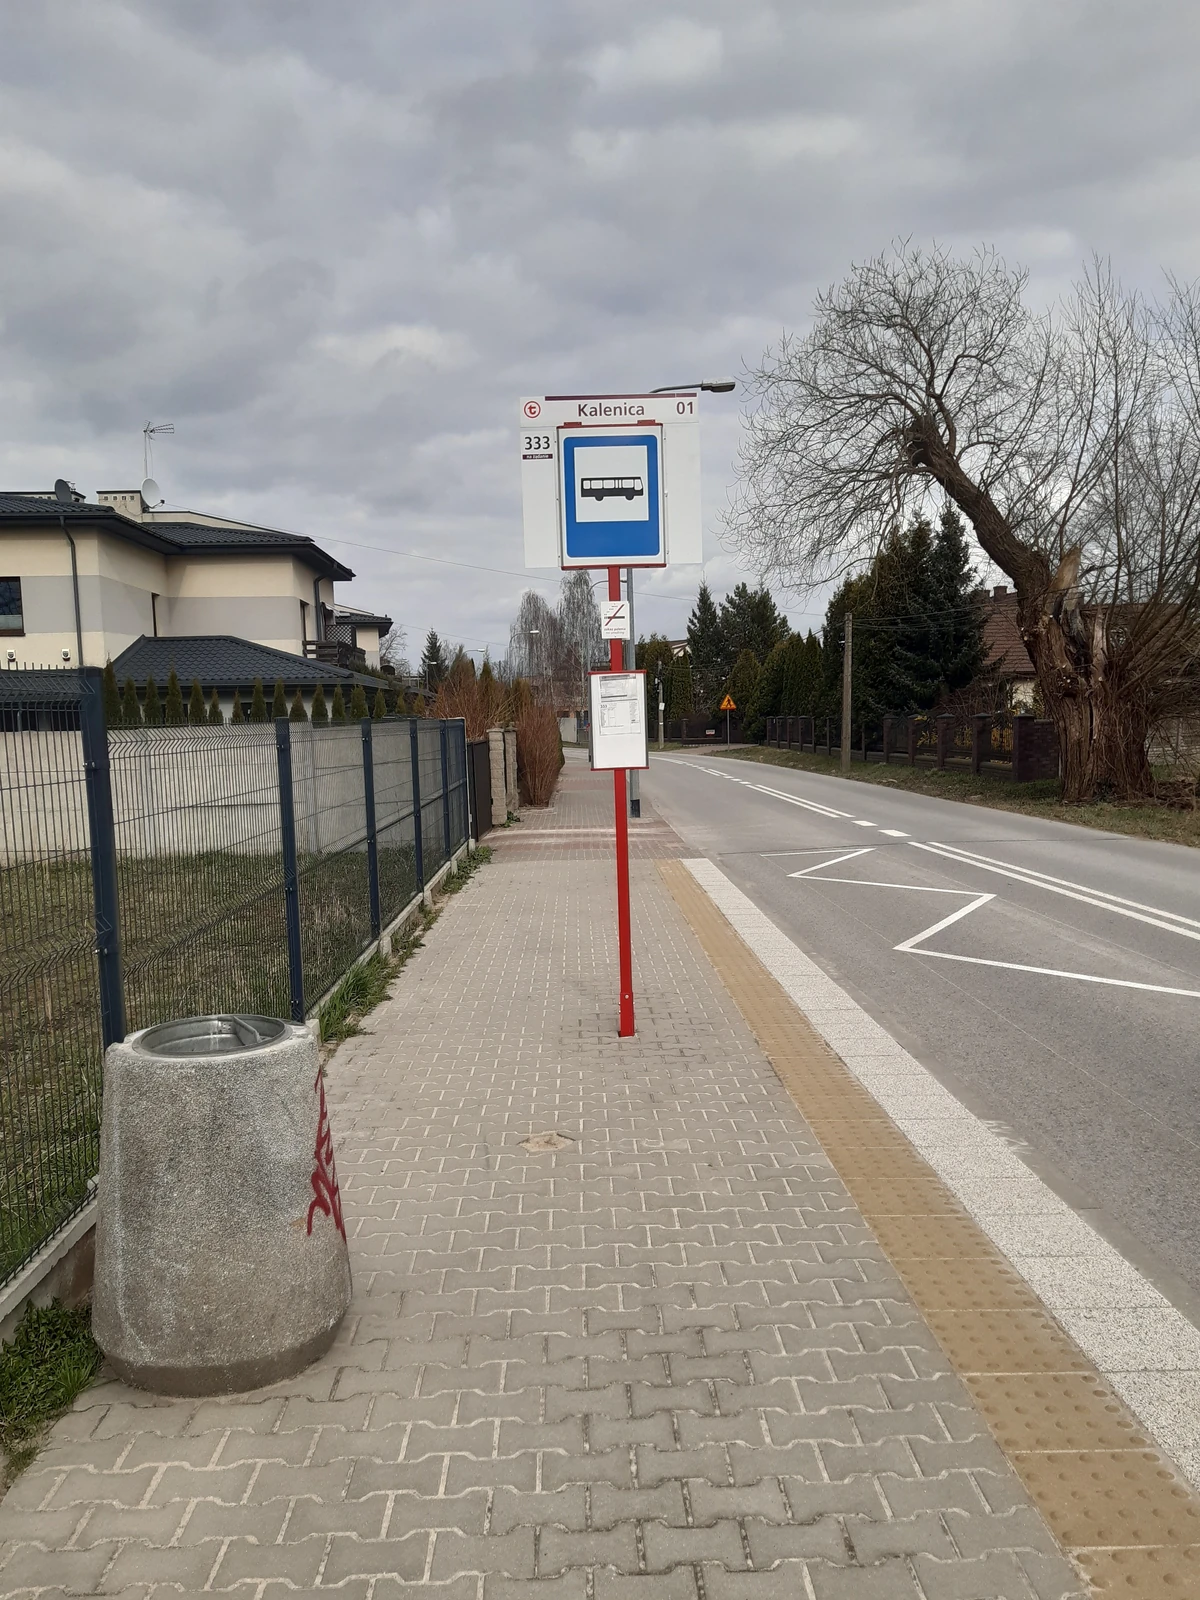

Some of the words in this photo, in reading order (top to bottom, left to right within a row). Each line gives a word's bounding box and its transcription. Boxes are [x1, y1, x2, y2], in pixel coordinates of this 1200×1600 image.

[578, 403, 645, 417] Kalenica
[676, 402, 693, 415] 01
[524, 436, 550, 450] 333
